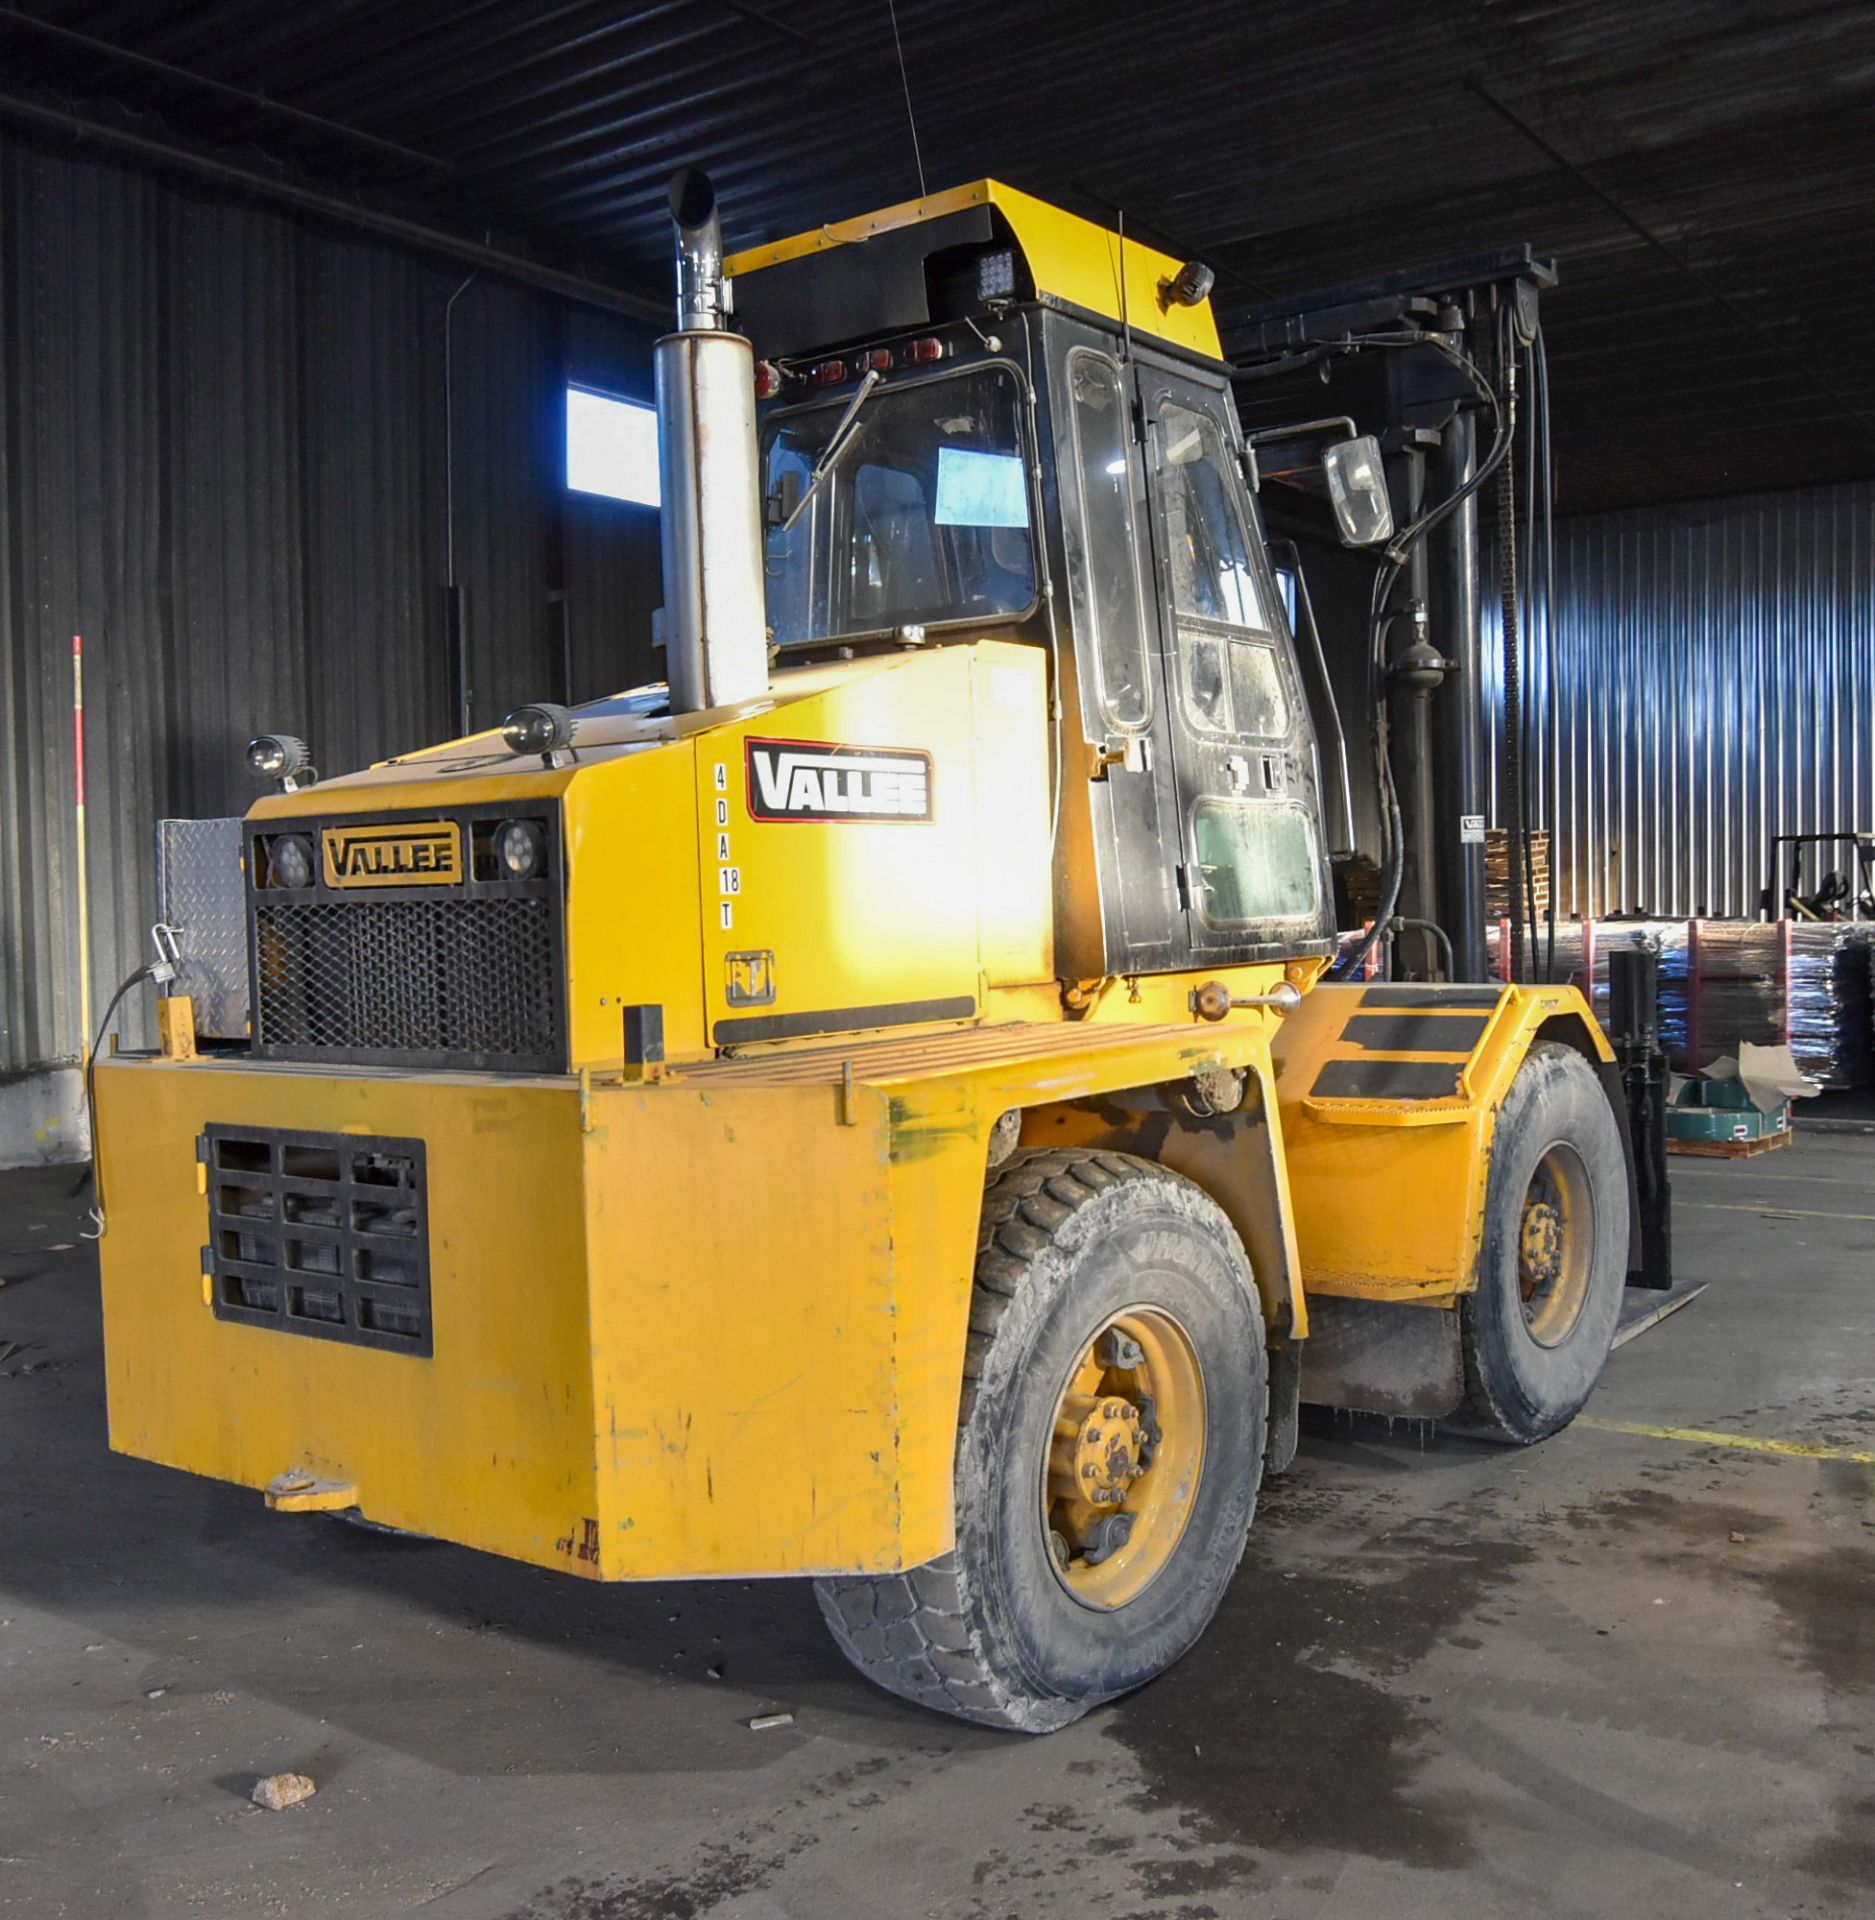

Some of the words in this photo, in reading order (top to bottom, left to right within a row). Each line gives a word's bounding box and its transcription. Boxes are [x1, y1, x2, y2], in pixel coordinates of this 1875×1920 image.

[752, 751, 928, 814] VALLEE
[327, 831, 453, 875] VALLEE
[723, 869, 739, 892] 18
